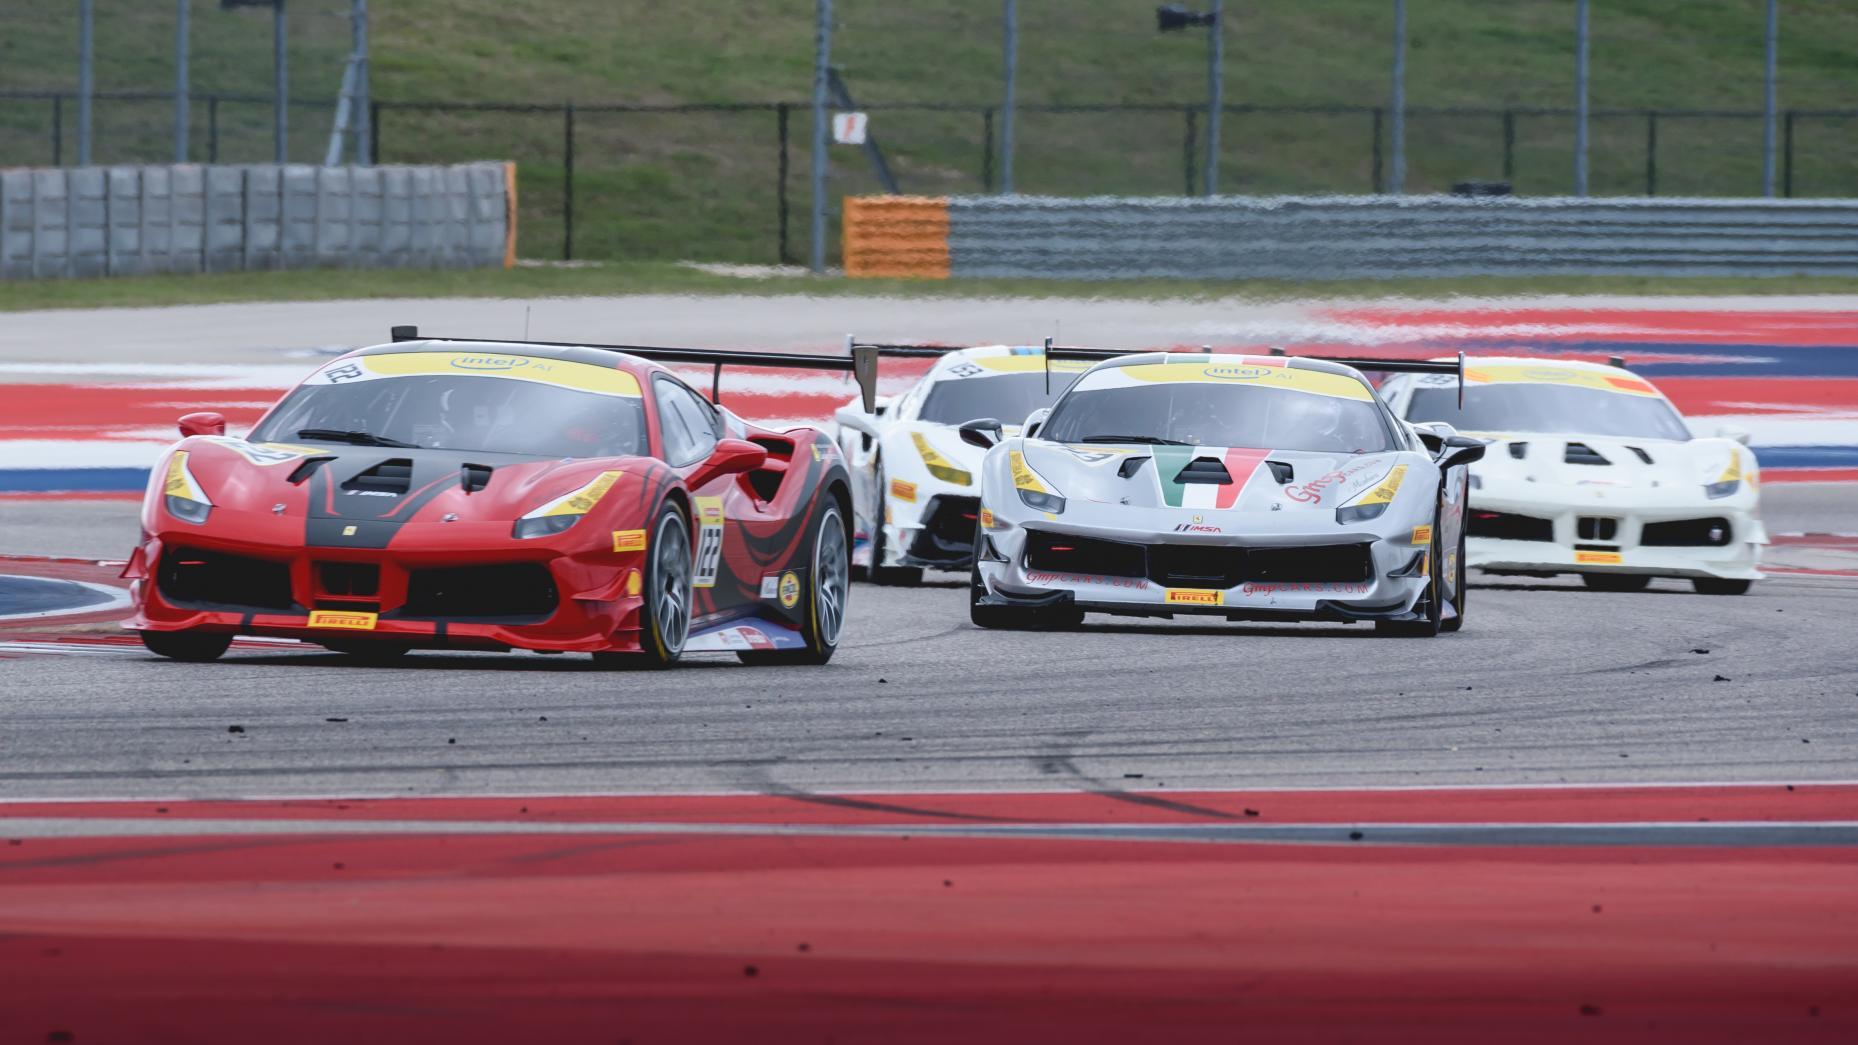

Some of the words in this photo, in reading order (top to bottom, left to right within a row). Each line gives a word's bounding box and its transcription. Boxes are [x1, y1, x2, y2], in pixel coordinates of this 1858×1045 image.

[461, 356, 516, 367] intel
[324, 363, 362, 383] 122
[1212, 367, 1260, 377] intel
[694, 528, 722, 577] 122
[315, 614, 369, 626] PIRELLI
